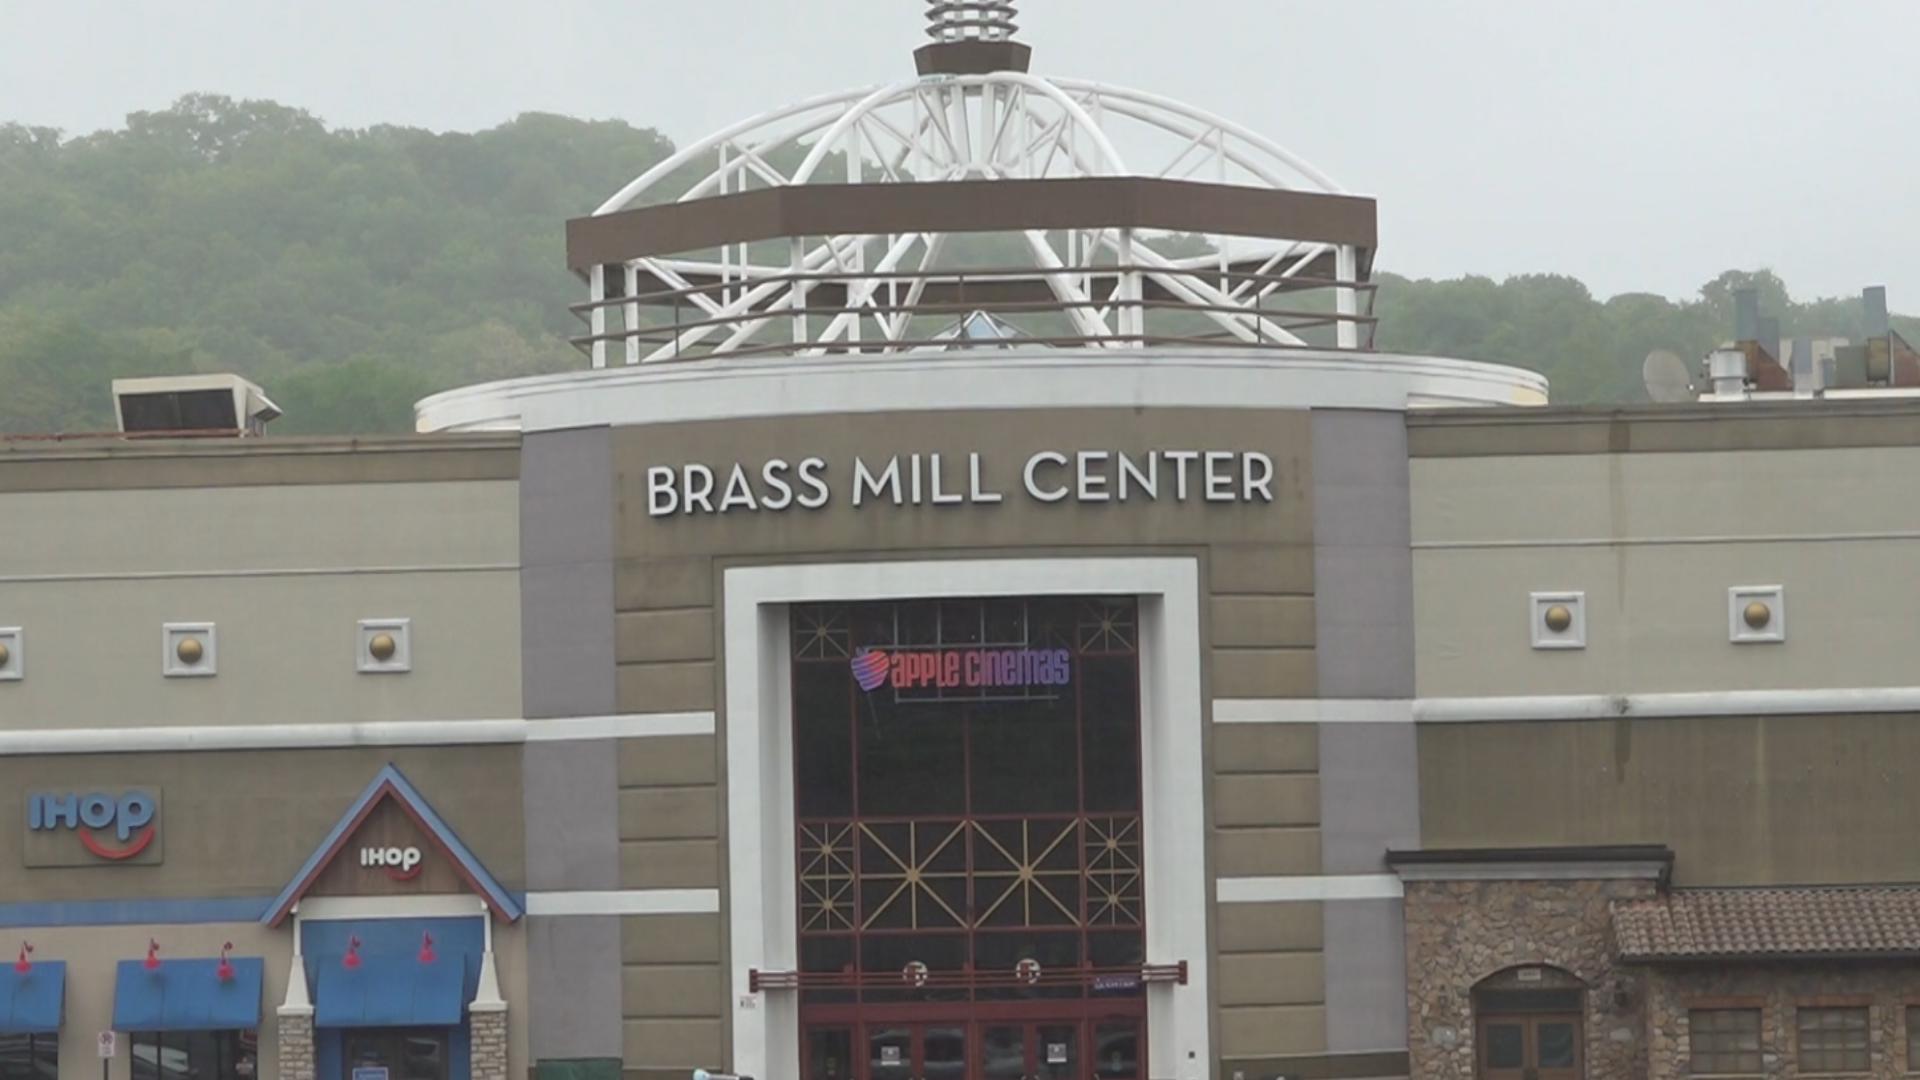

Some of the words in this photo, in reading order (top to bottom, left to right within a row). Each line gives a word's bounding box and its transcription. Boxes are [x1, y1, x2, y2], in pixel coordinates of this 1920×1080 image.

[647, 457, 830, 517] BRASS
[852, 452, 1002, 506] MILL
[1023, 450, 1275, 502] CENTER
[890, 650, 960, 688] apple
[964, 648, 1070, 686] cinemas
